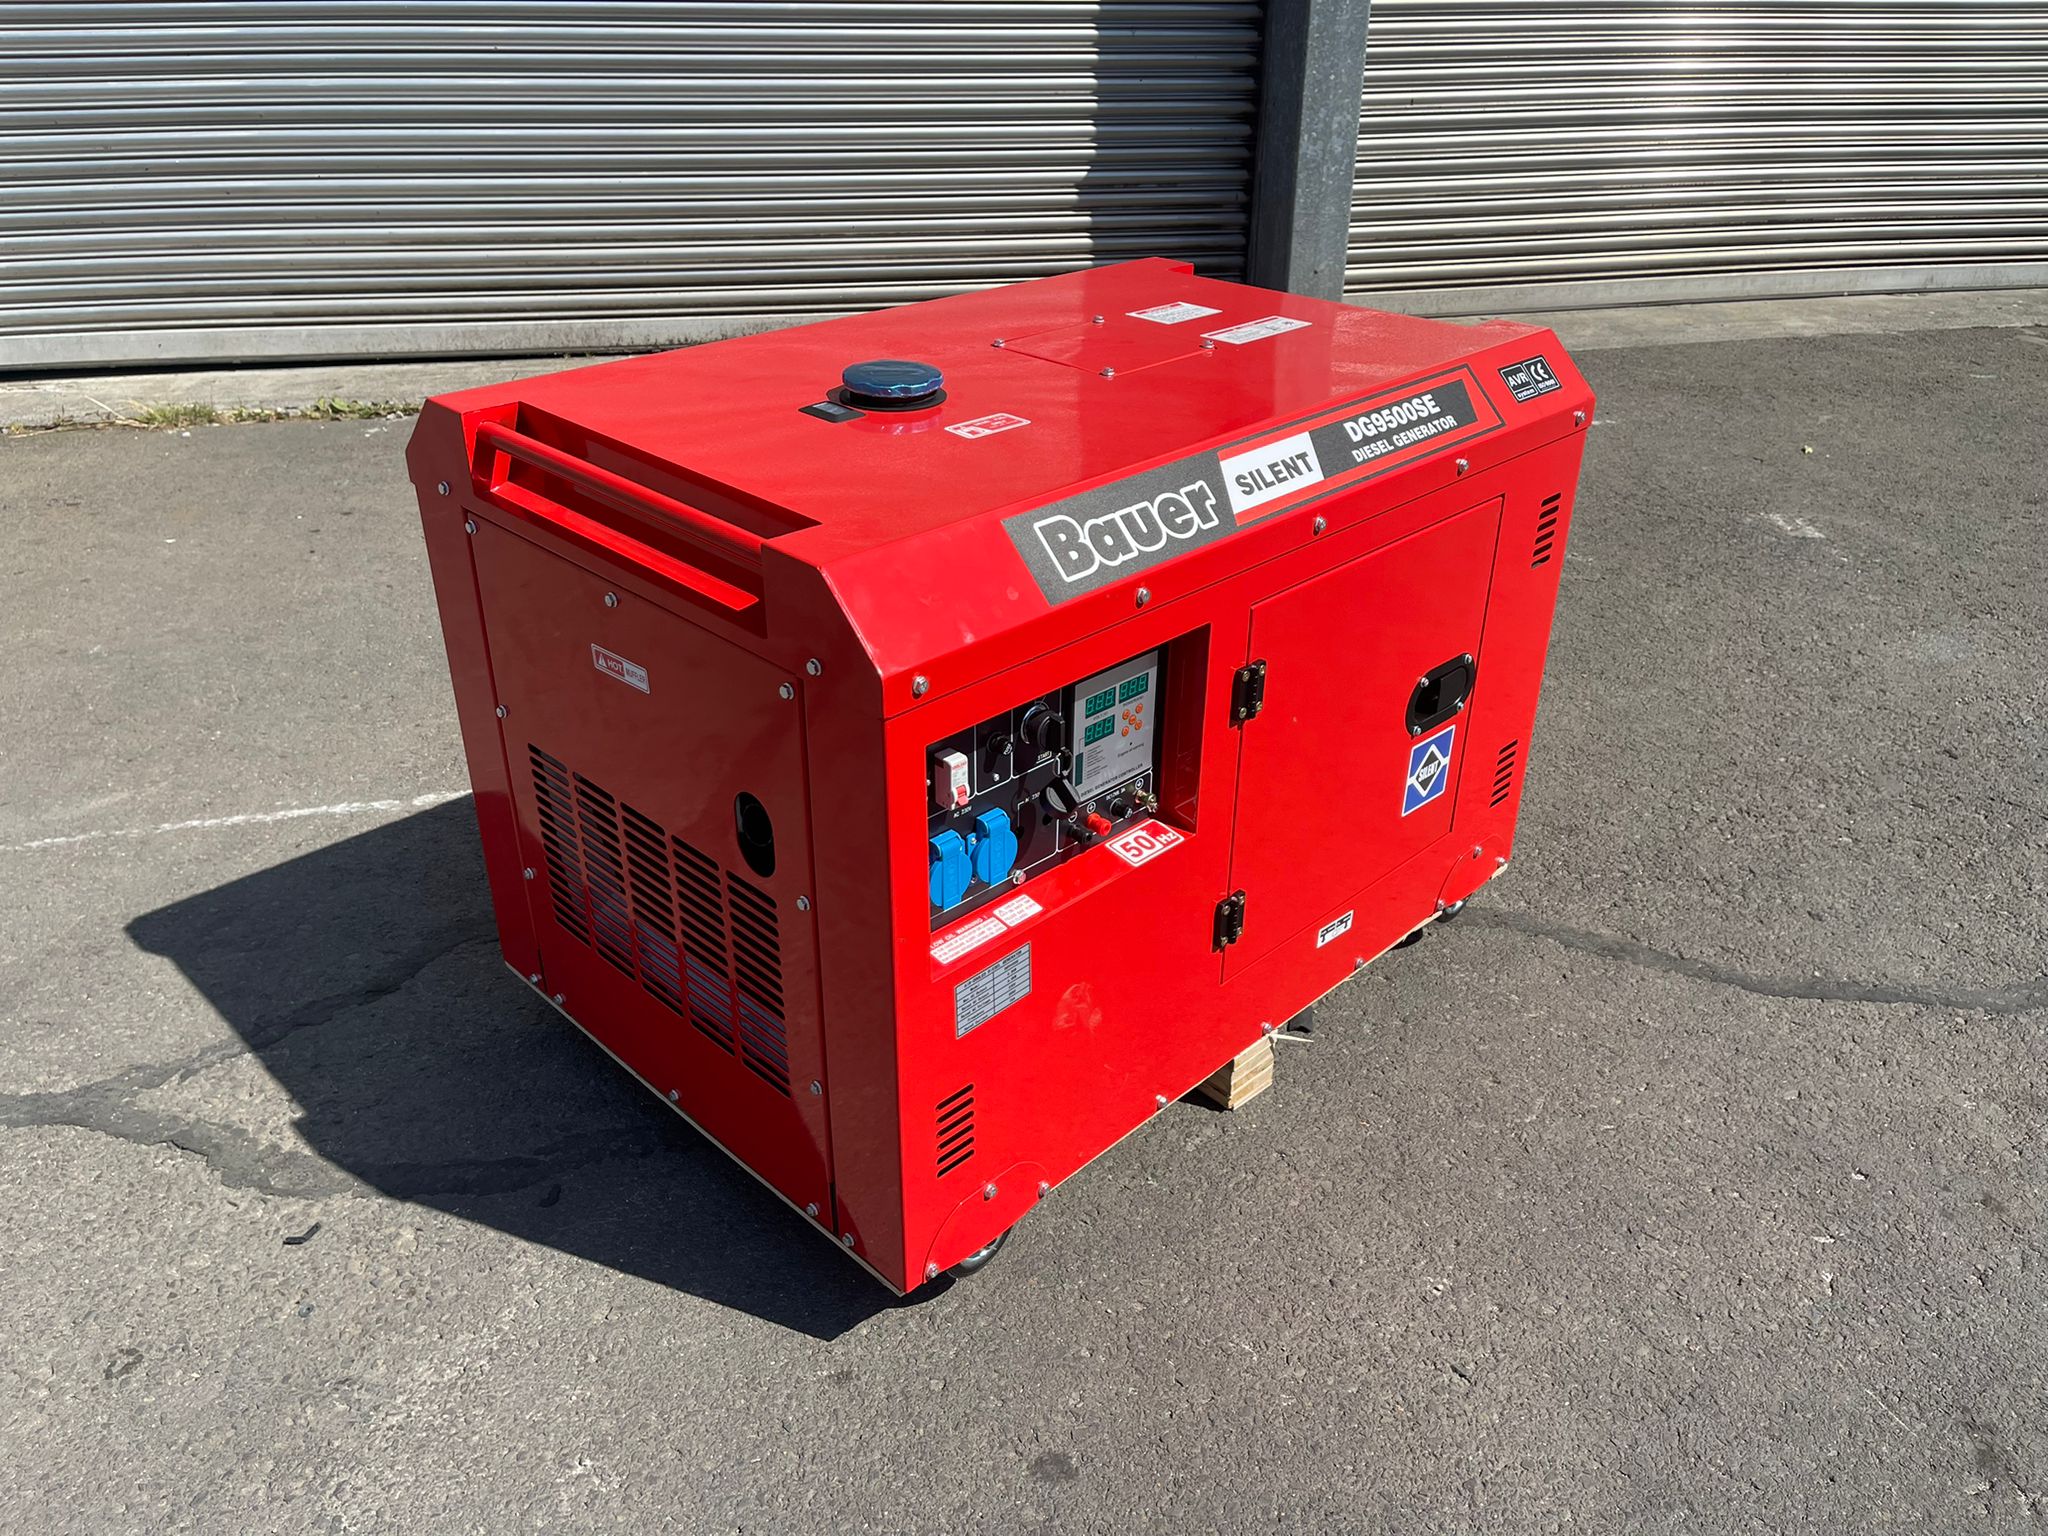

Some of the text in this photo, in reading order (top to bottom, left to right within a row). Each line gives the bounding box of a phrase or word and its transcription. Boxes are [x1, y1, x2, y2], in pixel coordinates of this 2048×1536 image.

[1507, 372, 1529, 387] AVR
[1343, 394, 1441, 443] DG9500SE
[1352, 415, 1458, 463] DIESEL GENERATOR
[1235, 452, 1315, 496] SILENT
[1033, 480, 1219, 583] Bauer
[607, 658, 623, 672] HOT
[1120, 832, 1178, 858] 50 Hz
[930, 938, 945, 949] LOW
